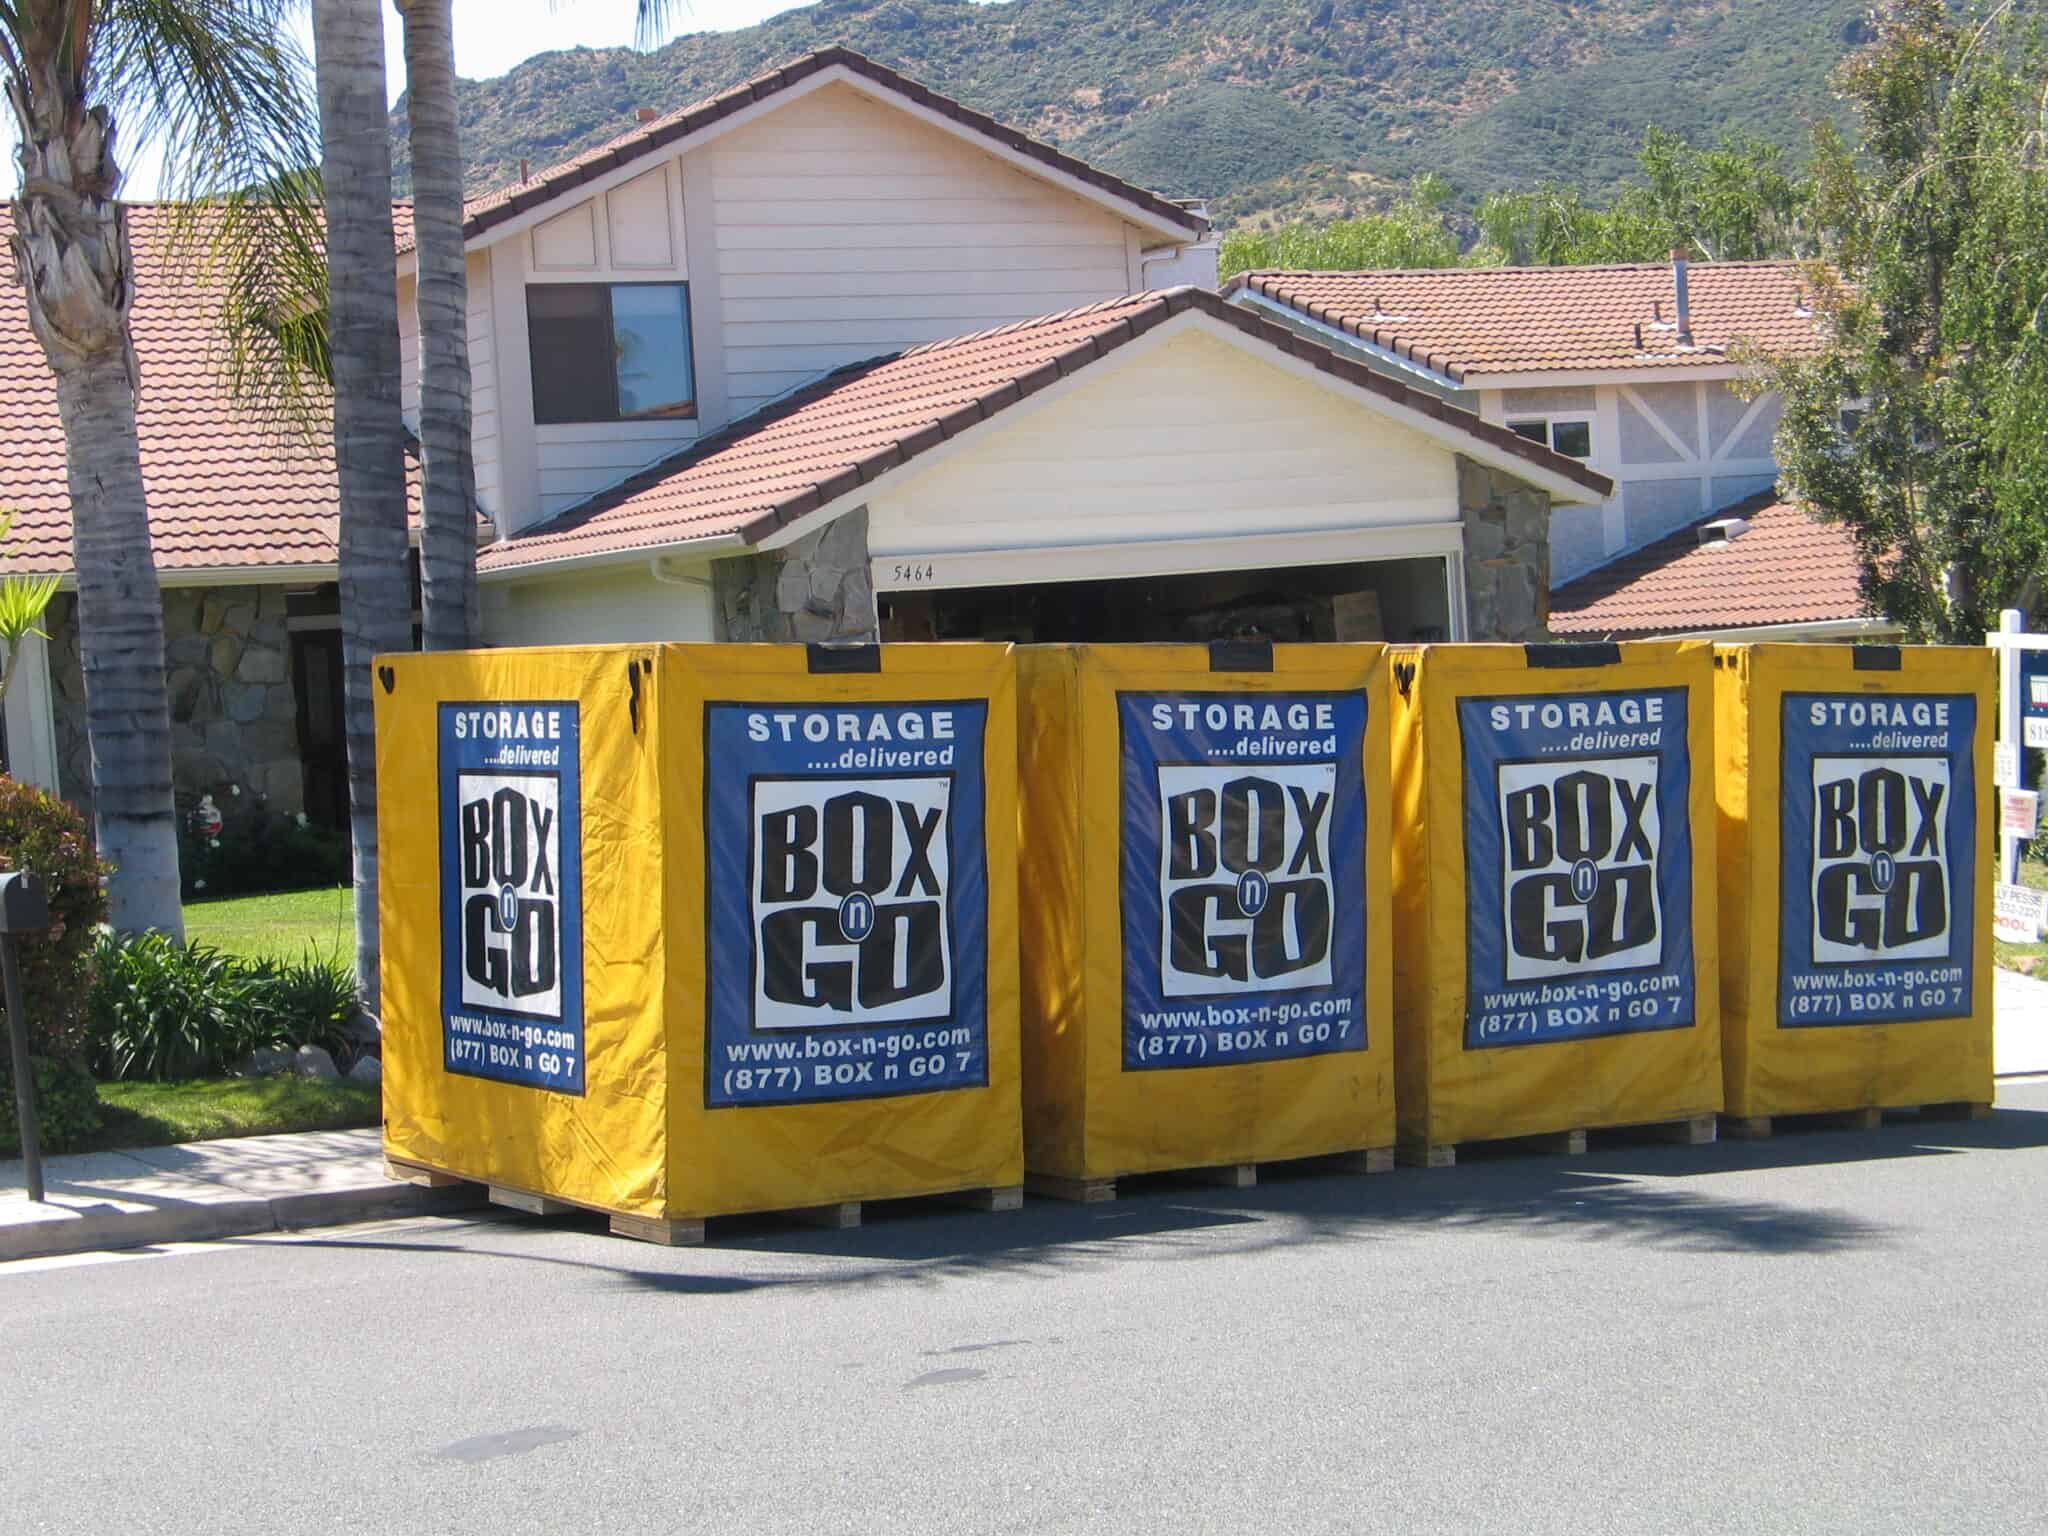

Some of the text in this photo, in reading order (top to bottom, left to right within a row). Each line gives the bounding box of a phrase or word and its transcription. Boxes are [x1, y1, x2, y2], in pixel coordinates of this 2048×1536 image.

[893, 564, 933, 582] 5464
[455, 711, 560, 739] STORAGE
[747, 711, 955, 742] STORAGE
[1152, 703, 1335, 731] STORAGE
[1490, 698, 1664, 731] STORAGE
[1810, 702, 1949, 726] STORAGE
[1168, 776, 1330, 880] BOX
[1506, 770, 1653, 872] BOX
[1818, 767, 1945, 859] BOX
[463, 786, 554, 896] BOX
[760, 791, 943, 903] BOX
[1510, 864, 1657, 963] GO
[1817, 859, 1946, 950] GO
[465, 893, 556, 998] GO
[1169, 877, 1331, 982] GO
[761, 900, 945, 1012] GO
[1484, 974, 1680, 1009] www.box-n-go.com
[1792, 968, 1962, 991] www.box-n-go.com
[1140, 997, 1352, 1029] www.box-n-go.com
[1479, 996, 1681, 1039] (877) BOX n GO 7
[1790, 988, 1963, 1017] (877) BOX n GO 7
[450, 1015, 575, 1050] www.box-n-go.com
[726, 1028, 971, 1062] www.box-n-go.com
[1137, 1020, 1351, 1061] (877) BOX n GO 7
[450, 1038, 576, 1077] (877) BOX n GO 7
[723, 1051, 971, 1095] (877) BOX n GO 7
